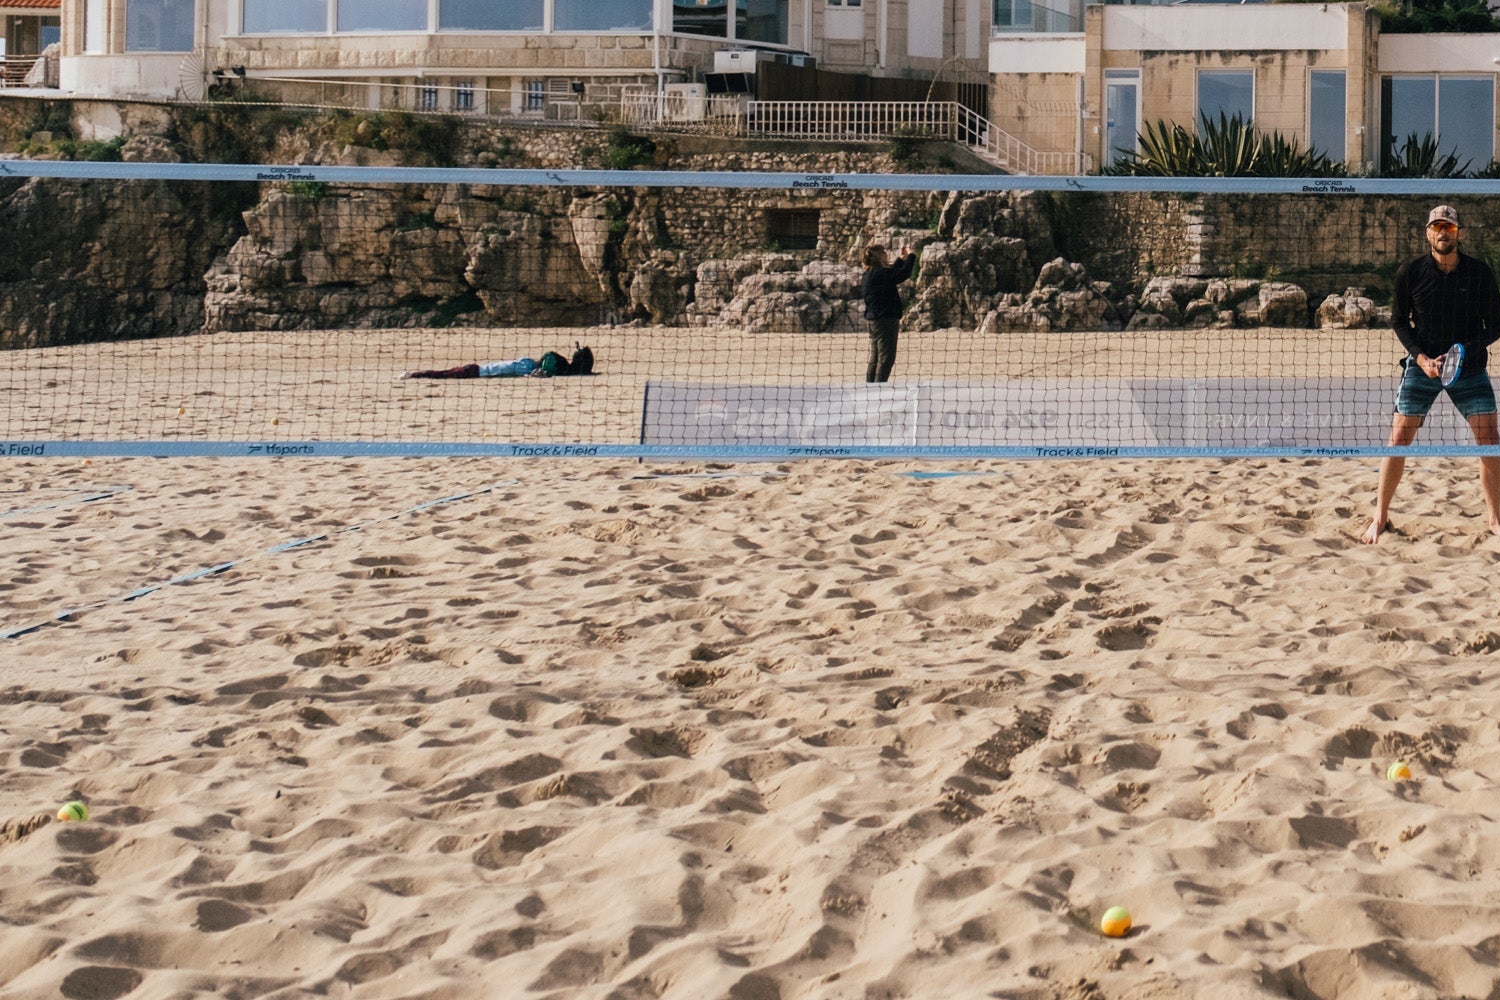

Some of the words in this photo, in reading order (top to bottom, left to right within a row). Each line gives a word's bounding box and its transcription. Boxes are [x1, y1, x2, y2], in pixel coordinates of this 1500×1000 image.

[792, 180, 820, 188] Beach
[821, 180, 848, 188] Tennis
[1329, 185, 1356, 193] Tennis
[9, 443, 45, 455] Field
[266, 443, 314, 455] tfsports
[511, 445, 550, 456] Track
[563, 446, 598, 456] Field
[1086, 447, 1118, 456] Field
